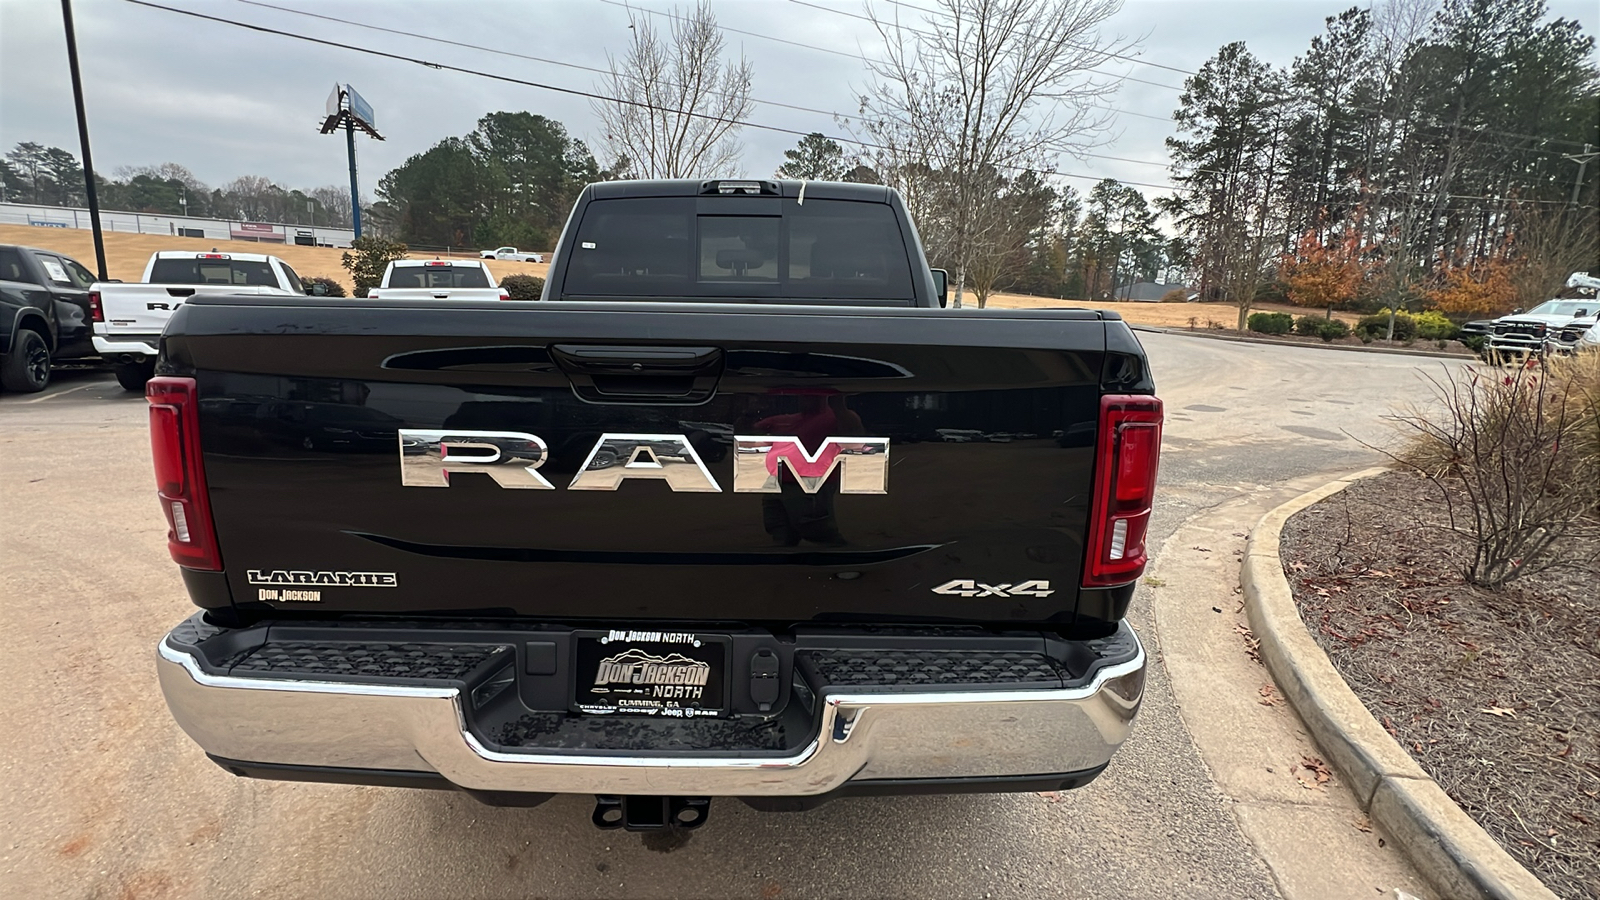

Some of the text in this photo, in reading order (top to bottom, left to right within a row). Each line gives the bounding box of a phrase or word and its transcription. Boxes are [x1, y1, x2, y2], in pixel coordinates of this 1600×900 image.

[398, 429, 889, 493] RAM
[247, 570, 397, 587] LARAMIE
[258, 589, 321, 602] DON JACKSON
[931, 579, 1055, 597] 4x4
[608, 630, 695, 644] DON JACKSON NORTH
[594, 662, 710, 686] DON JACKSON
[652, 685, 703, 698] NORTH
[661, 707, 683, 717] Jeep
